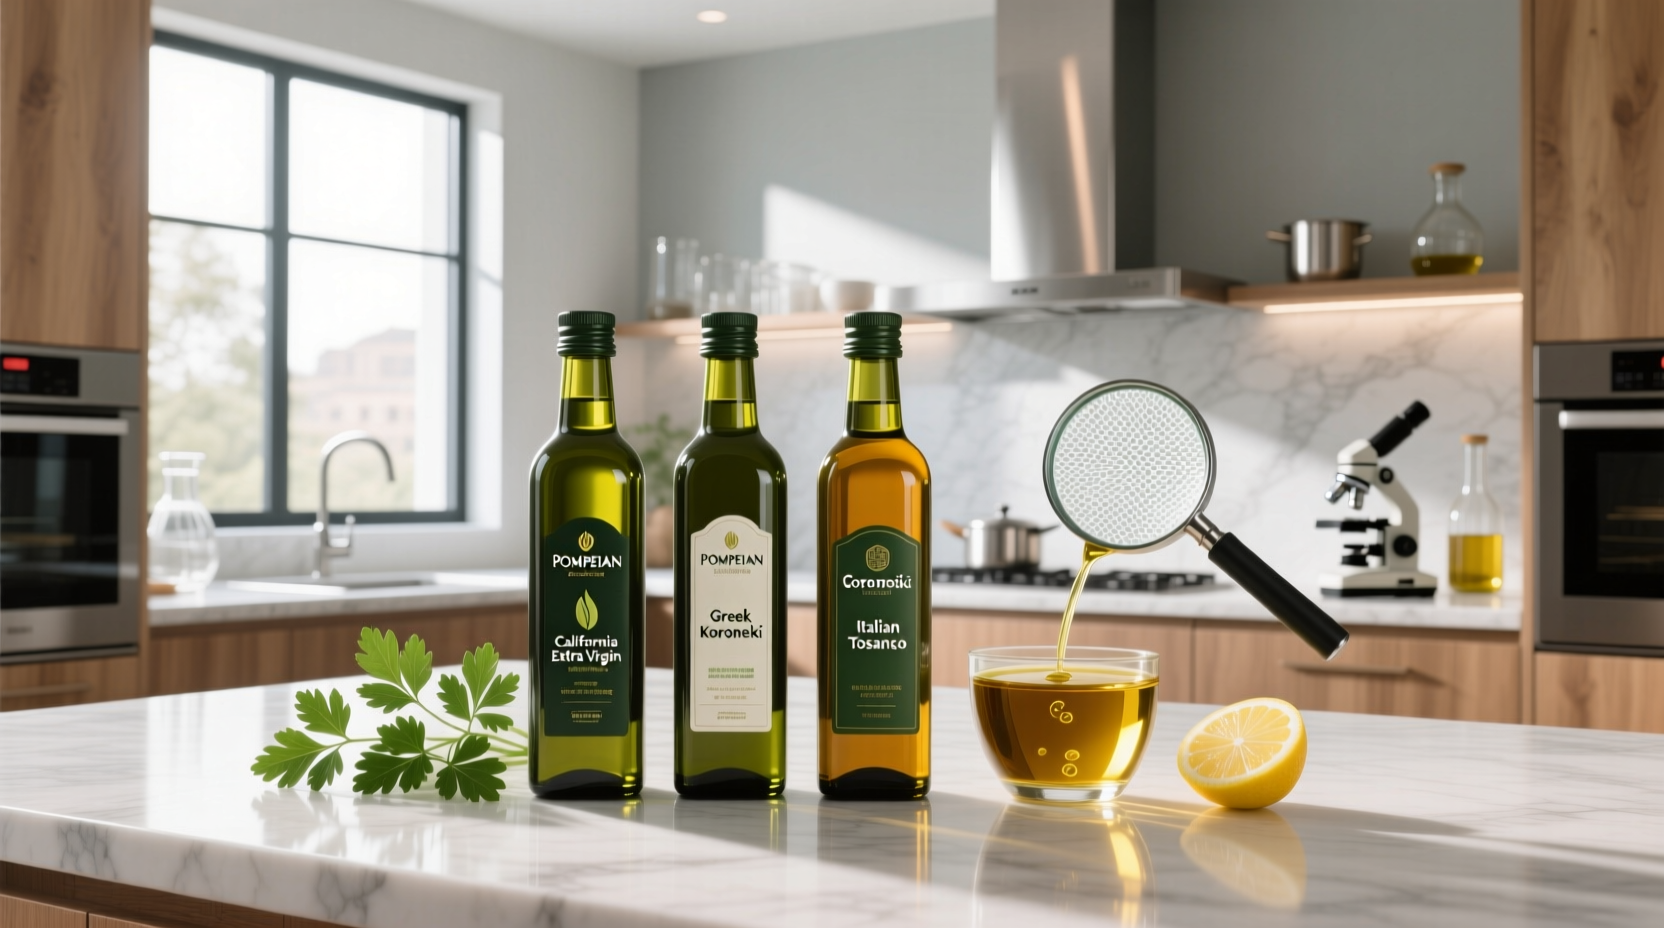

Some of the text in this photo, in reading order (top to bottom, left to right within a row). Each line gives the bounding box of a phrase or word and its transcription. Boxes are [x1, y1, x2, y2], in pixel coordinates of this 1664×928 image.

[553, 554, 622, 568] POMPEIAN
[701, 553, 763, 566] POMPEIAN
[710, 608, 752, 623] Greek
[700, 624, 763, 639] Koroneki
[857, 619, 900, 634] Italian
[554, 634, 618, 648] California
